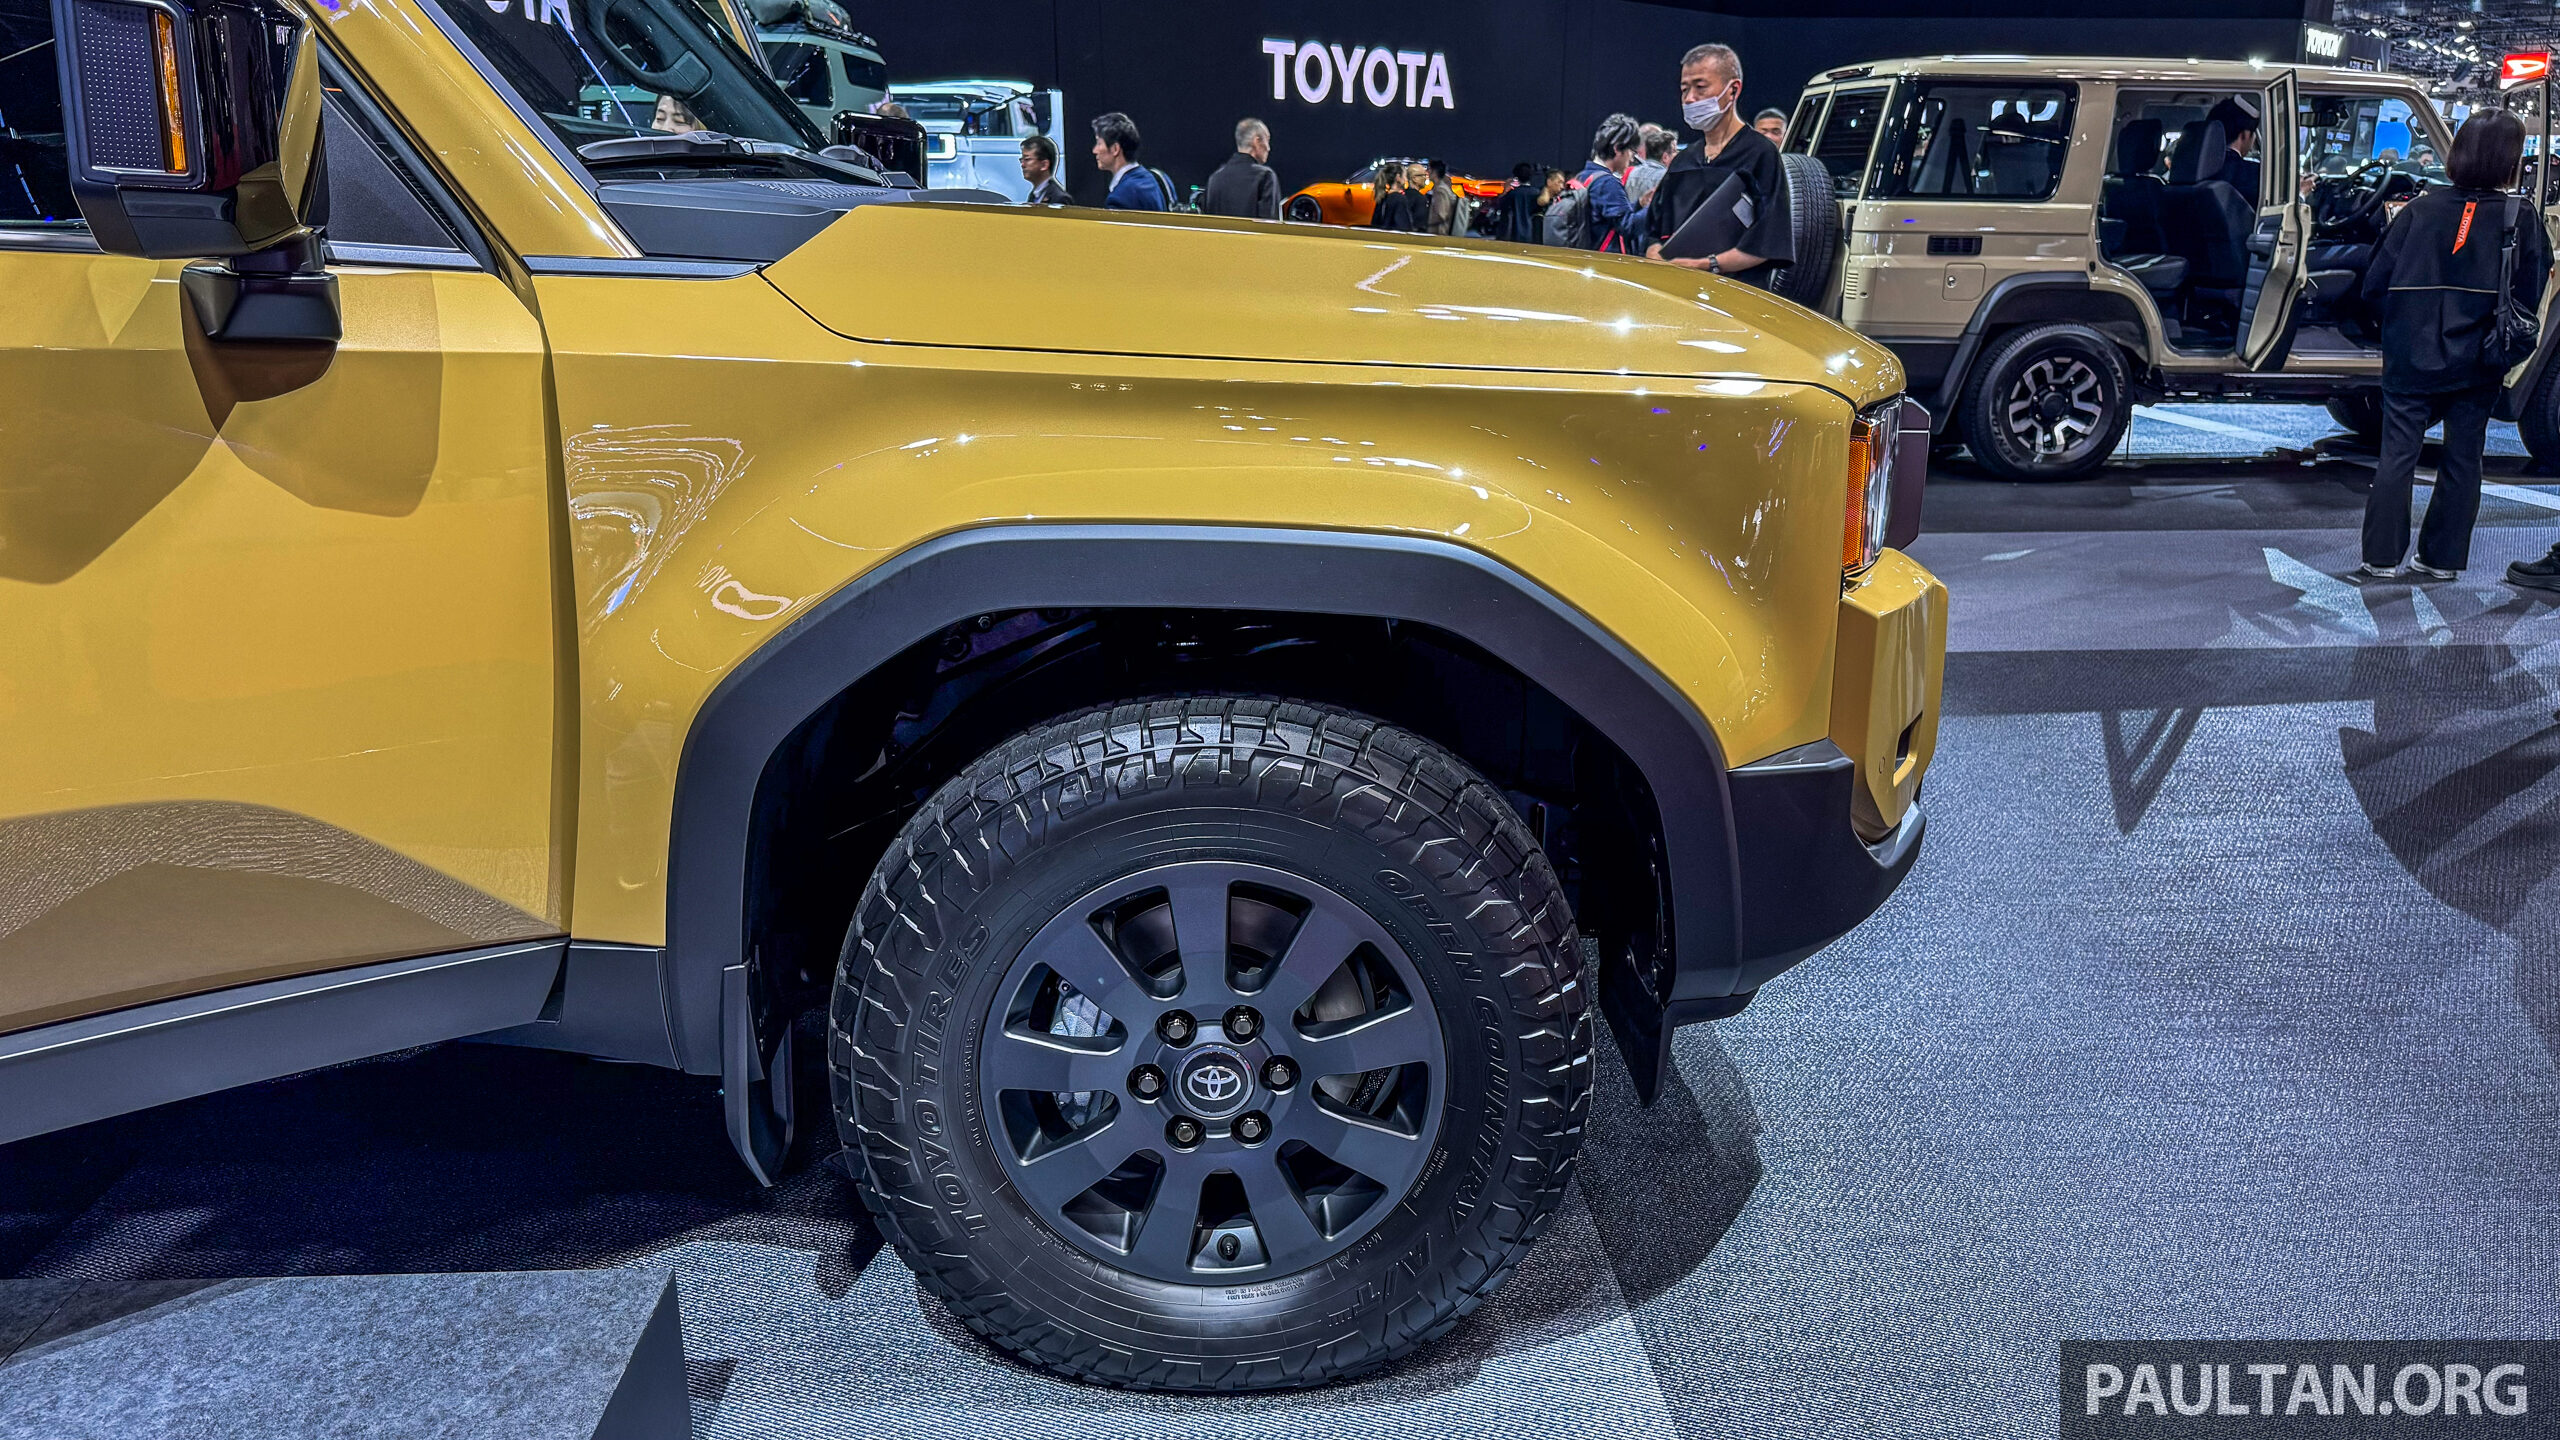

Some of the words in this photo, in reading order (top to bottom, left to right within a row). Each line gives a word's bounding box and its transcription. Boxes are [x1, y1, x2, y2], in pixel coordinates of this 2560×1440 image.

[1262, 37, 1455, 109] TOYOTA
[2456, 215, 2470, 243] TOYOTA
[911, 913, 991, 1090] TIRES
[1371, 867, 1484, 984] OPEN
[1448, 994, 1511, 1237] COUNTRY
[912, 1098, 992, 1240] TOYO
